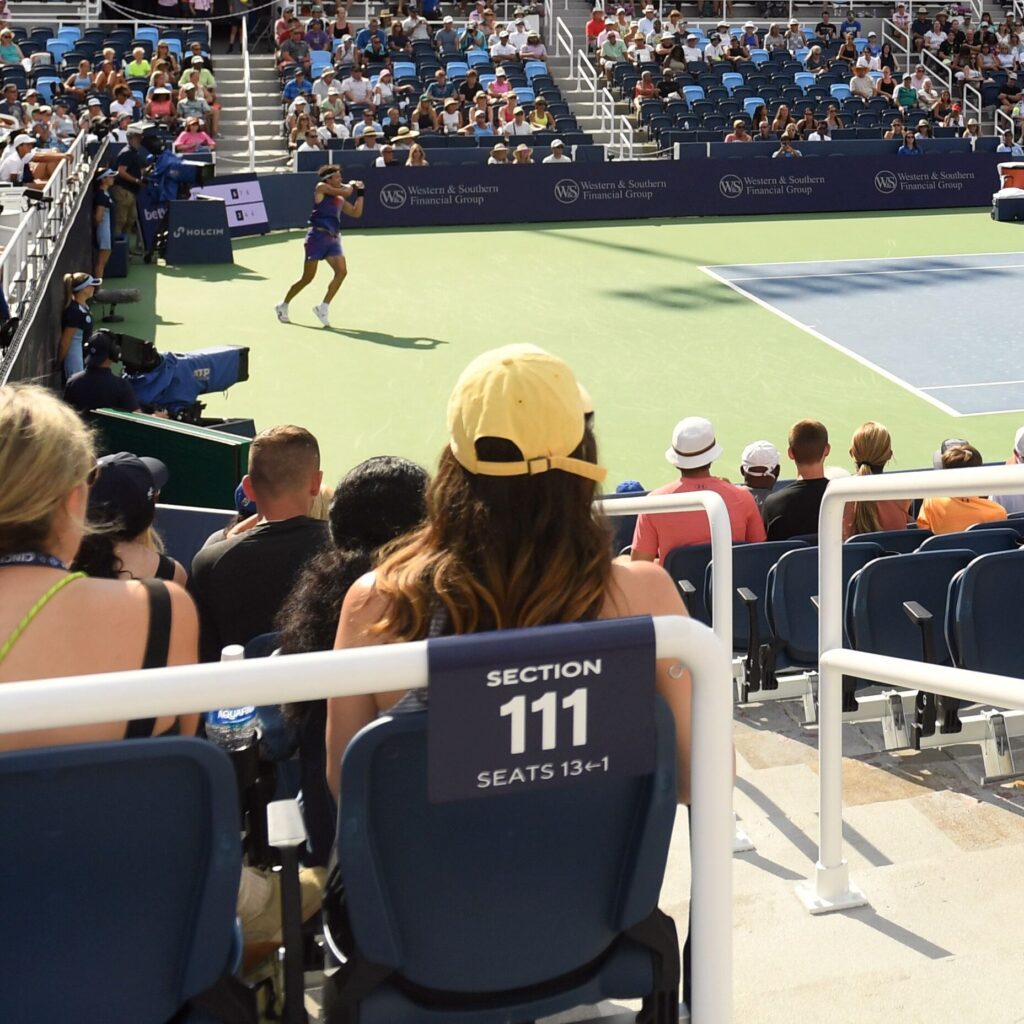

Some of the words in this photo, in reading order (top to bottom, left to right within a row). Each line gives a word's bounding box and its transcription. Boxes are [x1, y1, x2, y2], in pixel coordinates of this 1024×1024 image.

[743, 177, 777, 185] Western
[779, 176, 786, 184] &
[788, 175, 825, 184] Southern
[898, 173, 929, 181] Western
[930, 172, 938, 180] &
[940, 171, 975, 179] Southern
[408, 186, 445, 195] Western
[447, 184, 456, 194] &
[458, 184, 499, 193] Southern
[581, 181, 616, 190] Western
[618, 180, 626, 189] &
[628, 179, 667, 188] Southern
[900, 182, 936, 190] Financial
[938, 180, 963, 190] Group
[583, 191, 623, 200] Financial
[625, 189, 653, 200] Group
[746, 187, 783, 195] Financial
[786, 185, 813, 195] Group
[410, 196, 452, 205] Financial
[455, 195, 484, 205] Group
[186, 228, 224, 236] HOLCIM
[486, 659, 602, 687] SECTION
[500, 688, 588, 755] 111
[476, 764, 555, 789] SEATS
